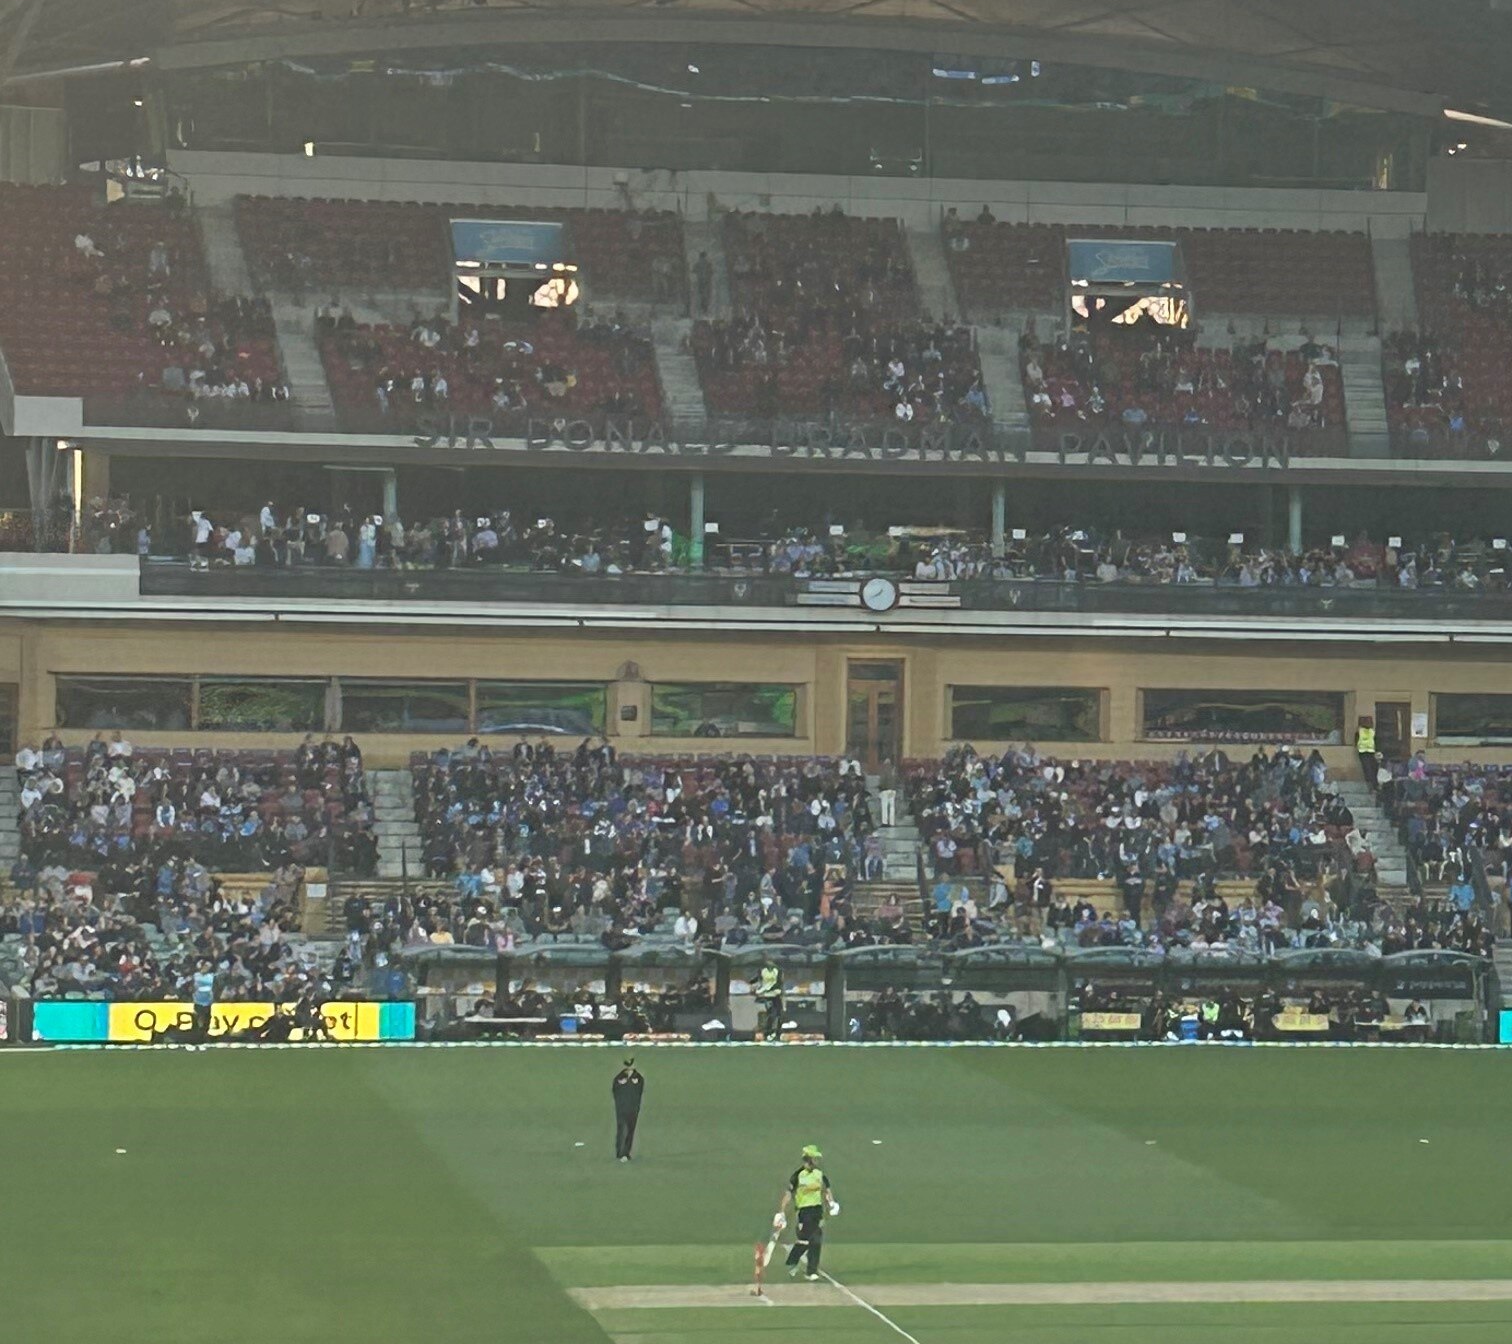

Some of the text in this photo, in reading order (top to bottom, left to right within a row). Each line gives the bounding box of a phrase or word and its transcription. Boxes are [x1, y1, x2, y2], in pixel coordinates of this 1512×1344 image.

[413, 414, 496, 450] SIR
[1059, 431, 1289, 469] PAVILION
[177, 1012, 239, 1033] Pay
